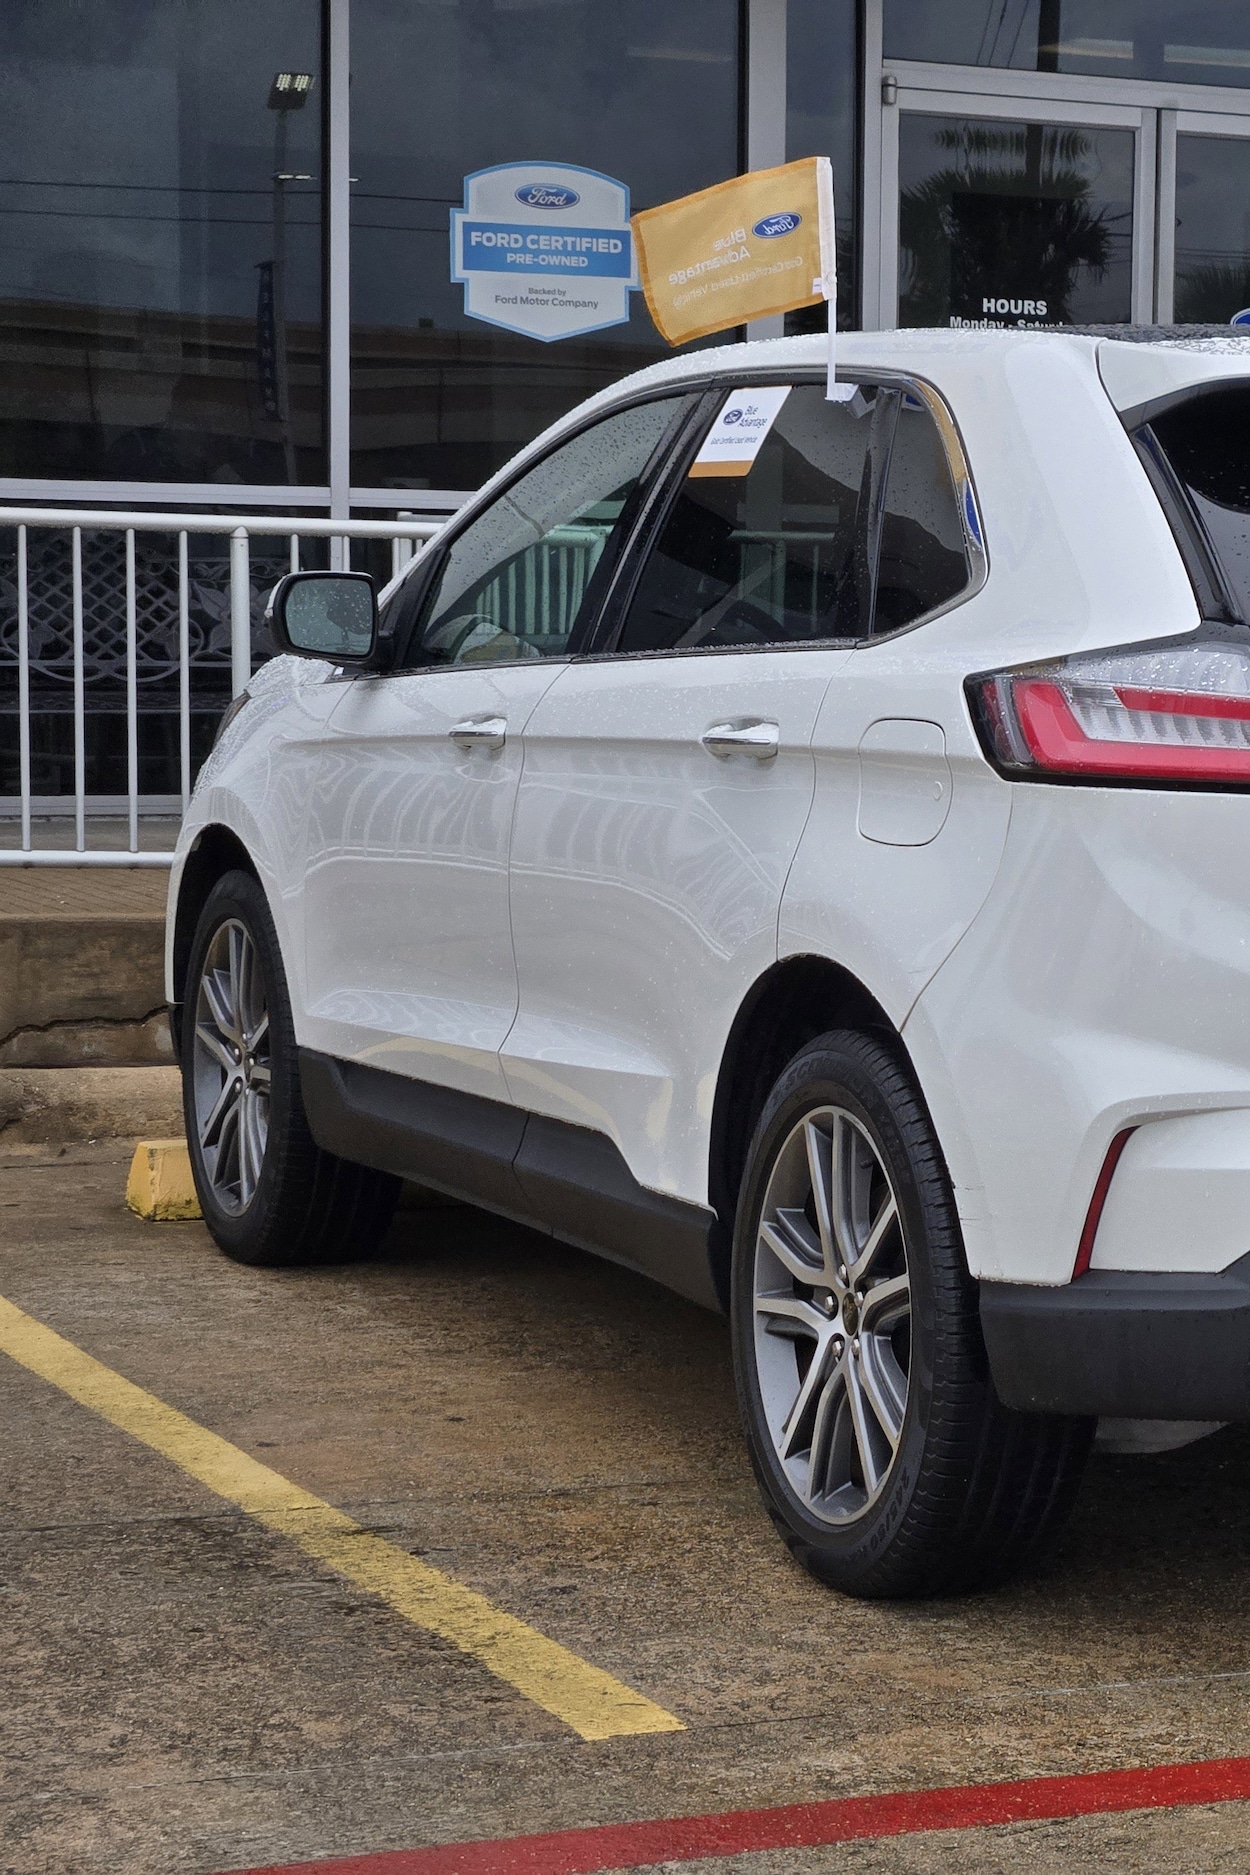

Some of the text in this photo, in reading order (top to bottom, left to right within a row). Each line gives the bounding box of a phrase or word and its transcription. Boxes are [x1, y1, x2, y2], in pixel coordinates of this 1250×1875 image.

[470, 231, 623, 254] FORD CERTIFIED
[506, 252, 589, 268] PRE-OWNED
[528, 286, 567, 299] Backed by
[494, 294, 599, 310] Ford Motor Company
[982, 297, 1048, 316] HOURS
[949, 316, 1005, 330] Monday
